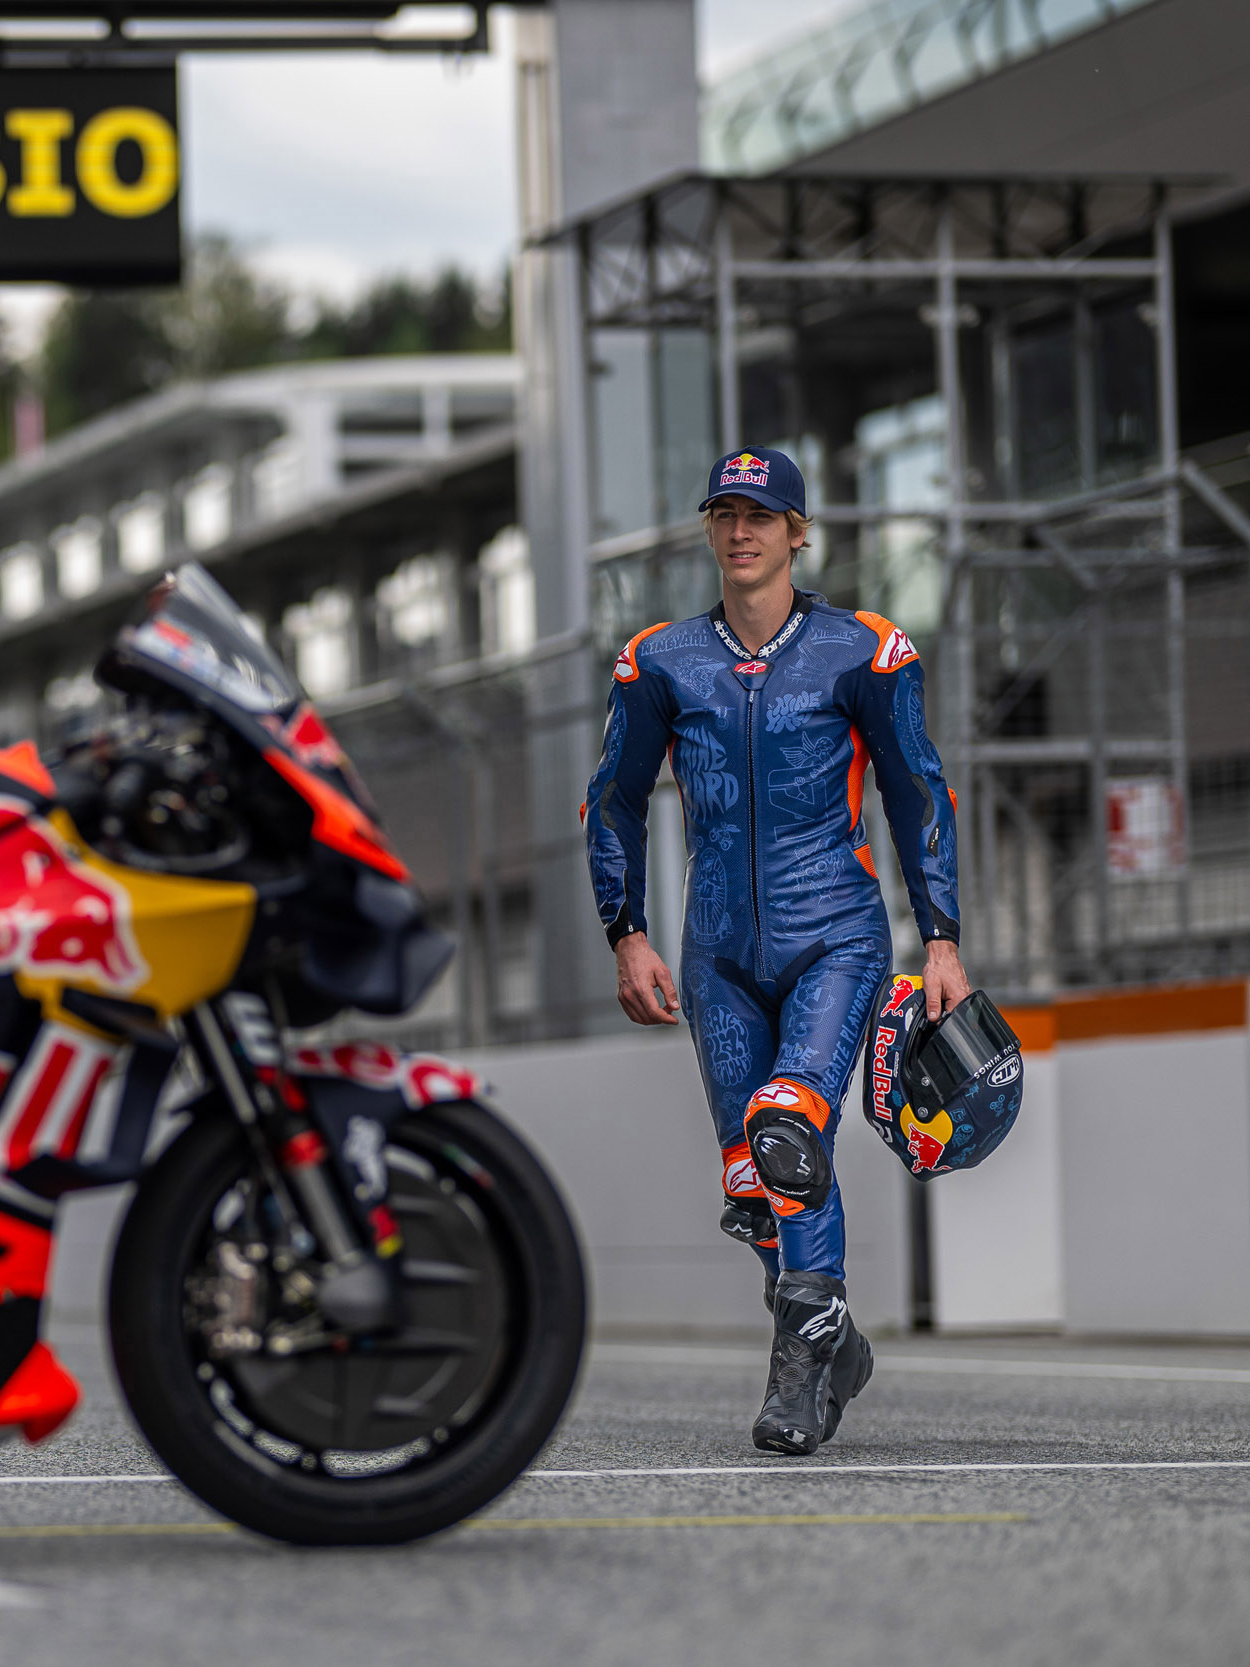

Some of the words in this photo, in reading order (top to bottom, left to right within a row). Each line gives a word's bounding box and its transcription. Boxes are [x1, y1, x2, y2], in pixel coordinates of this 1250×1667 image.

[720, 470, 743, 486] Red
[743, 471, 768, 487] Bull
[713, 619, 752, 660] alpinestars
[758, 612, 804, 658] alpinestars
[772, 690, 823, 717] NINE
[873, 1025, 898, 1077] Red
[973, 1054, 1003, 1080] WINGS
[873, 1075, 894, 1122] Bull
